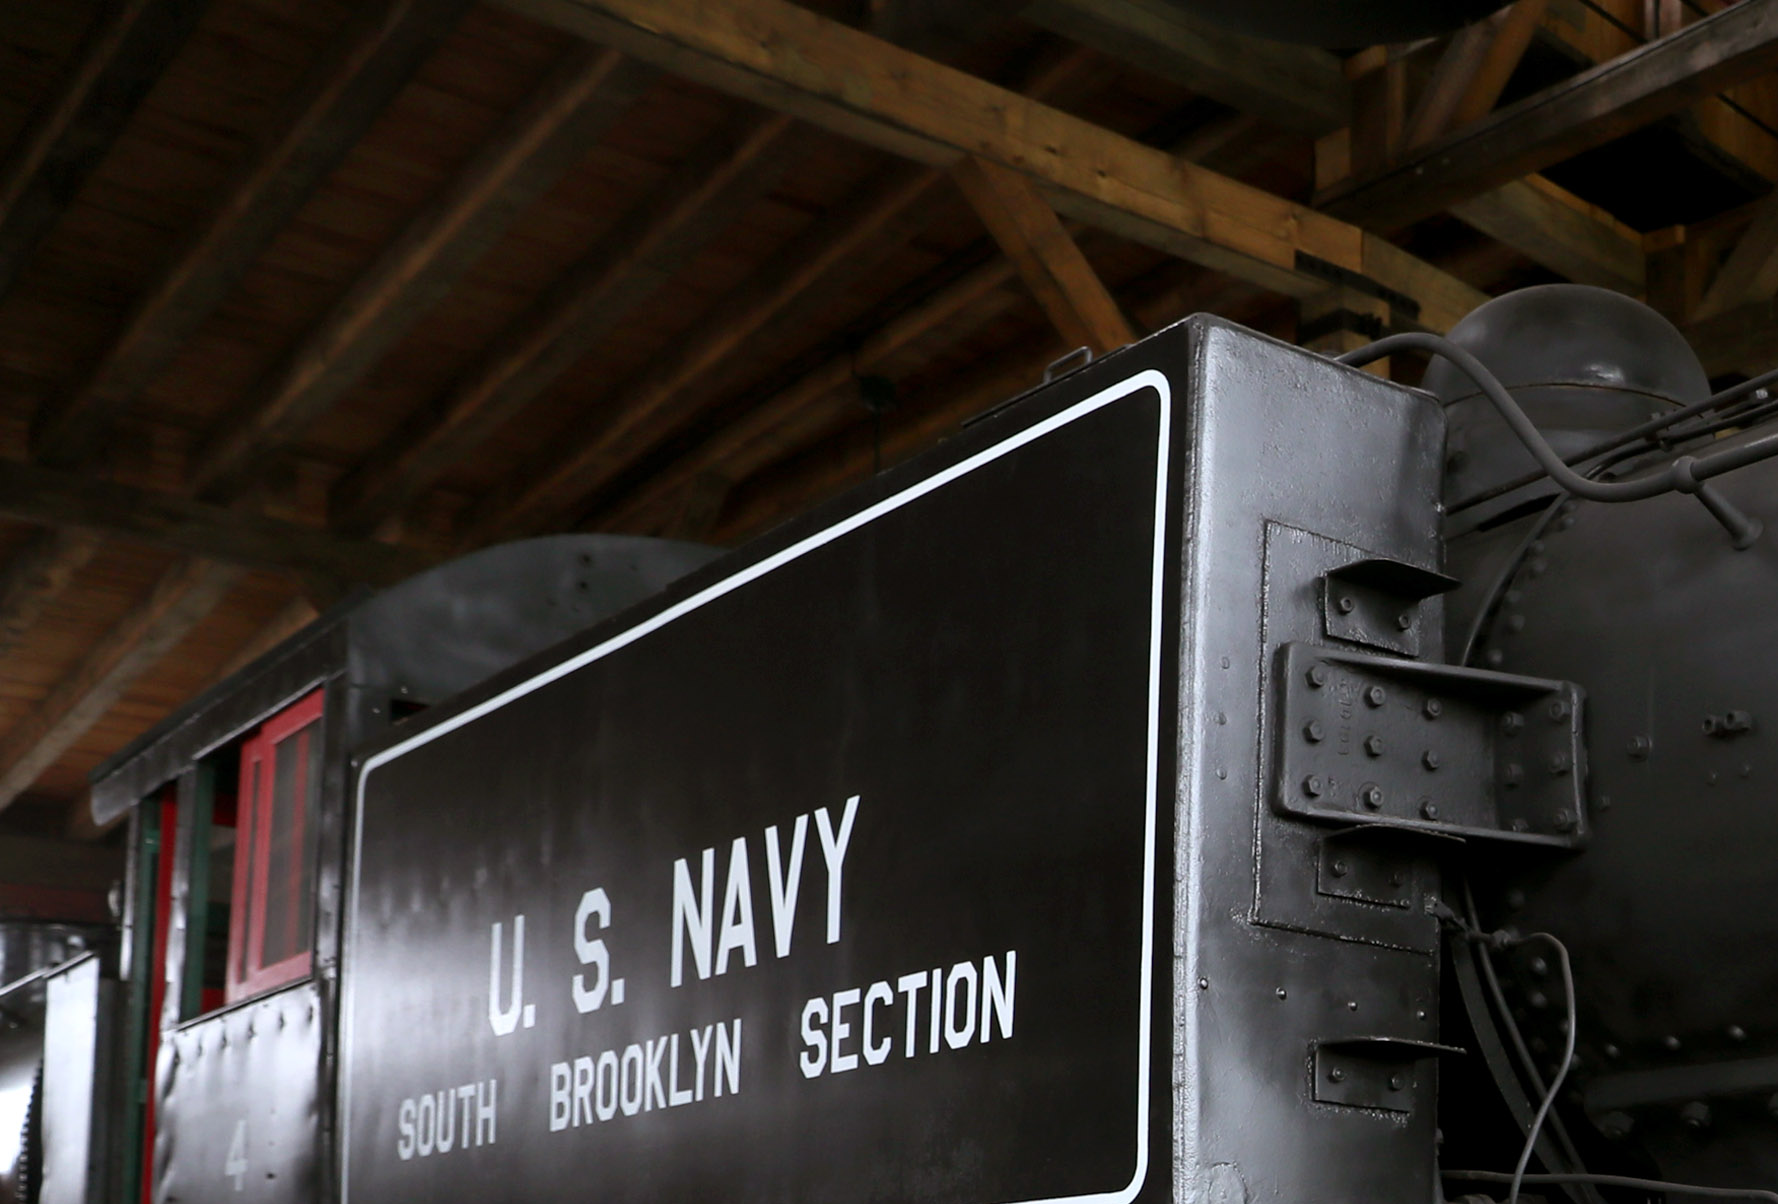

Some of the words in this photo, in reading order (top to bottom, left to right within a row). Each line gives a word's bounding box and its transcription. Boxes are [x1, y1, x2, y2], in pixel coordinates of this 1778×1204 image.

[488, 914, 536, 1036] U.
[572, 887, 625, 1014] S.
[670, 795, 860, 988] NAVY
[224, 1119, 249, 1191] 4
[399, 1079, 497, 1160] SOUTH
[549, 1018, 742, 1132] BROOKLYN
[800, 950, 1016, 1079] SECTION
